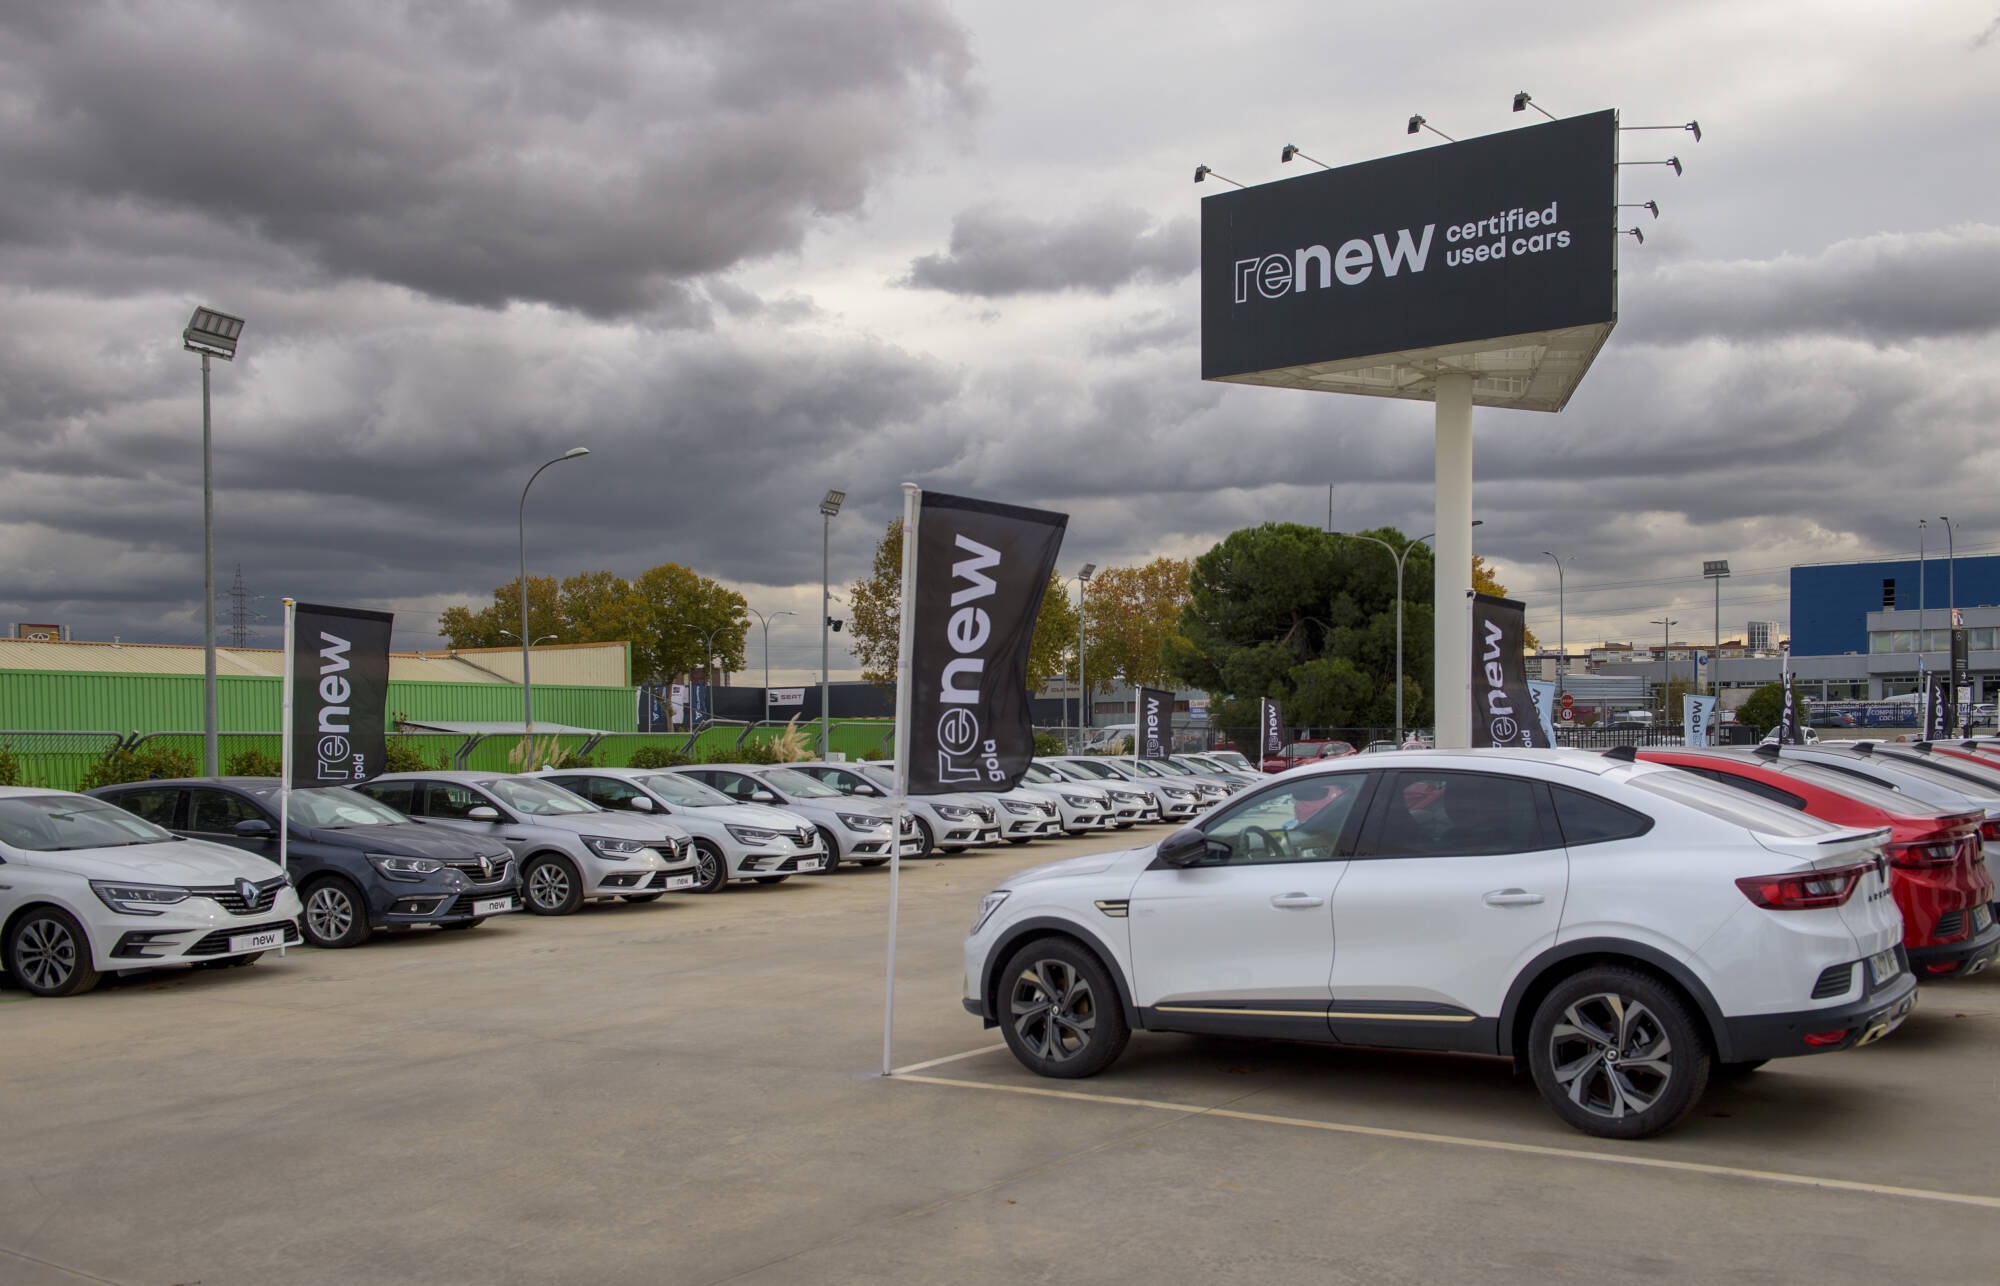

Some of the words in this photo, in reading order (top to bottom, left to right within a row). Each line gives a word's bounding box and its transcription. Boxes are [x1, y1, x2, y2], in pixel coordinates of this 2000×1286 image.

[1446, 201, 1558, 243] certified
[1235, 223, 1436, 304] renew
[1446, 235, 1507, 267] used
[1511, 230, 1571, 256] cars
[937, 533, 1001, 783] renew
[1483, 619, 1518, 748] enew
[317, 631, 351, 780] renew
[1146, 697, 1160, 758] renew
[981, 739, 1005, 783] gold
[1521, 729, 1532, 748] old
[353, 753, 366, 780] gold
